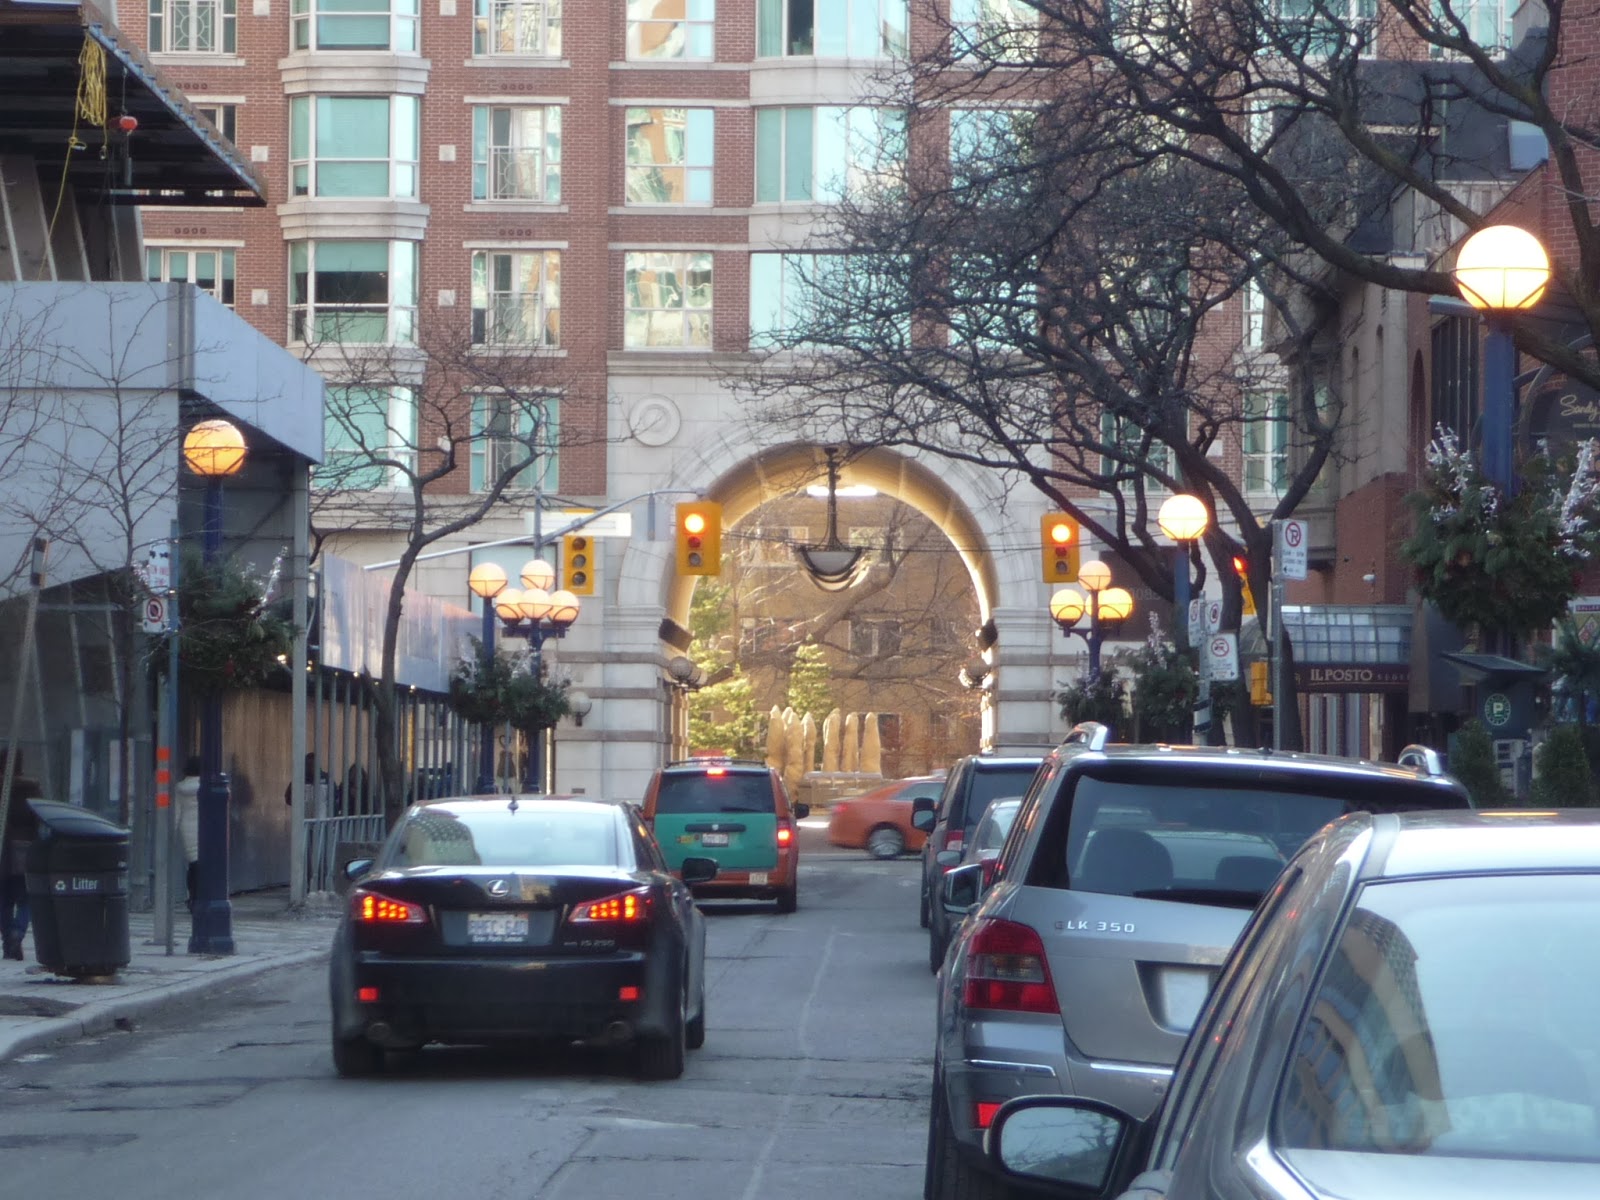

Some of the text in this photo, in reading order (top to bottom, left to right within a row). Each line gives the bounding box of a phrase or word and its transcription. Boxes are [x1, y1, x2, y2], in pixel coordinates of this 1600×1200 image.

[1310, 669, 1324, 681] IL
[1324, 669, 1373, 681] POSTO
[1493, 702, 1504, 714] P
[72, 877, 98, 890] Litter
[1097, 921, 1136, 933] 350
